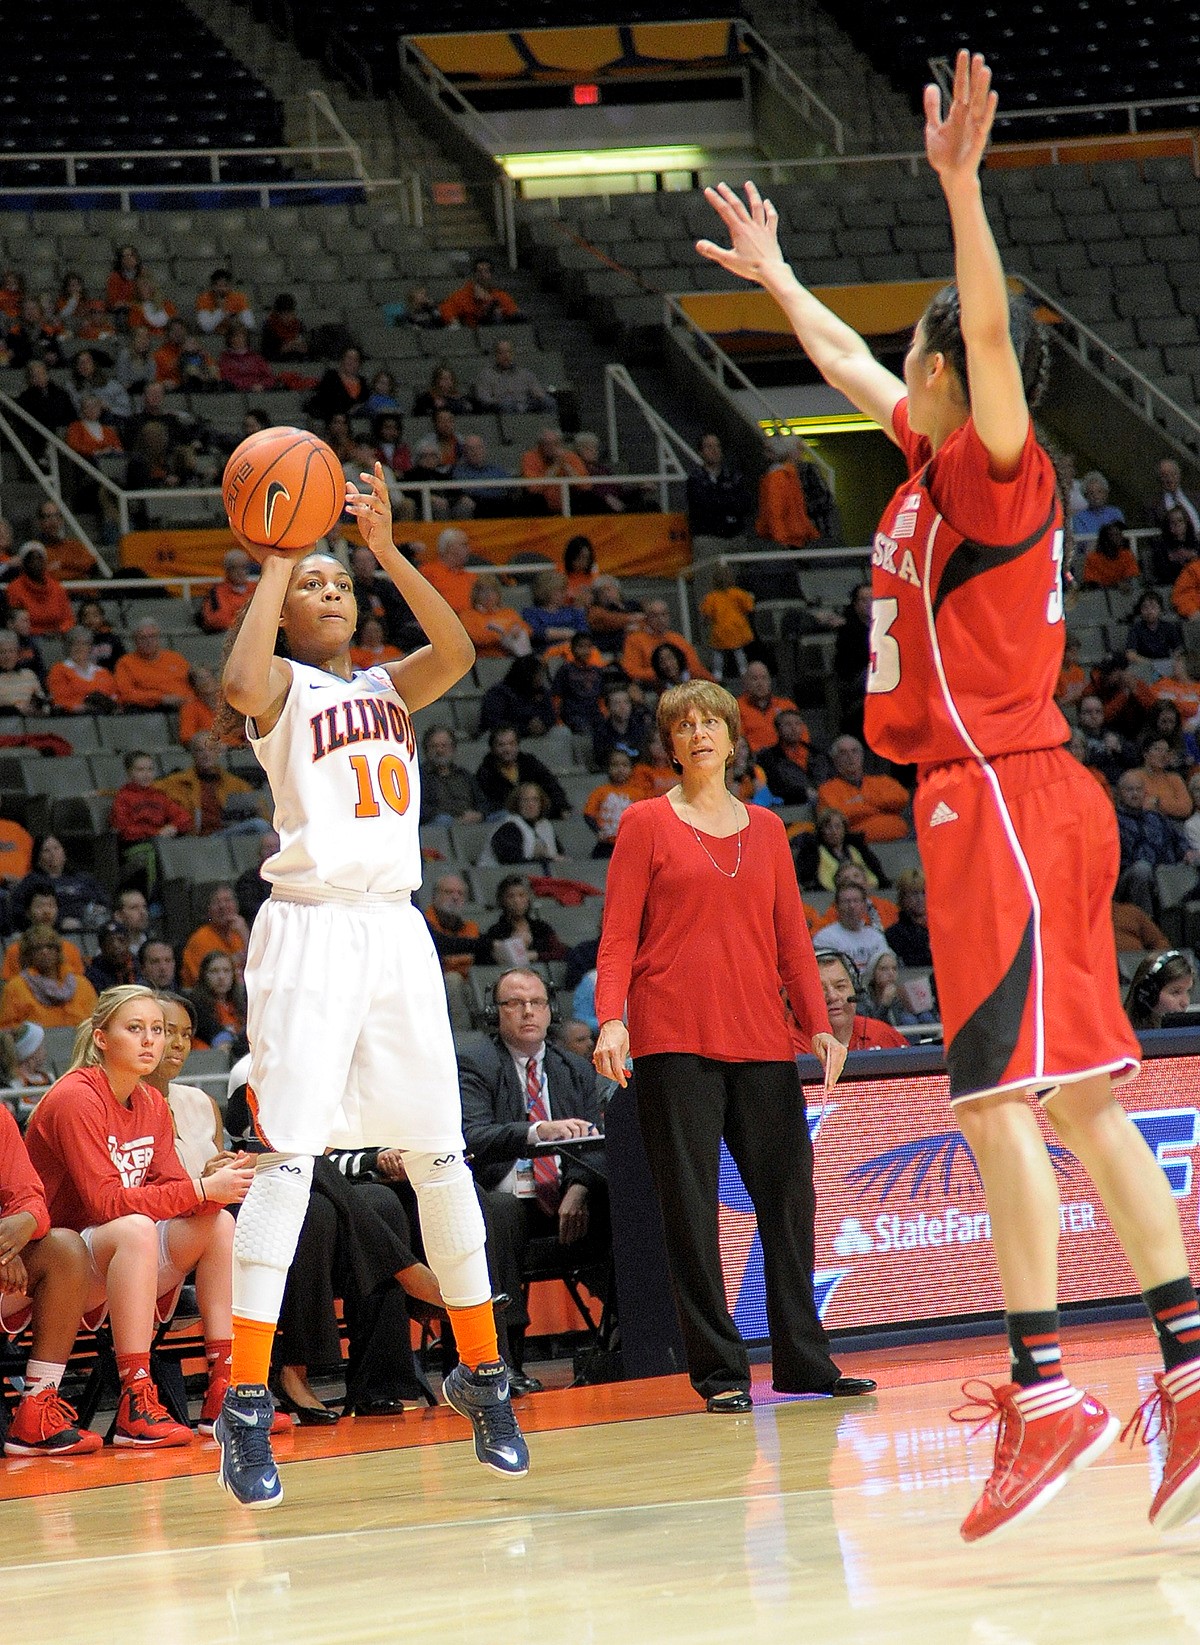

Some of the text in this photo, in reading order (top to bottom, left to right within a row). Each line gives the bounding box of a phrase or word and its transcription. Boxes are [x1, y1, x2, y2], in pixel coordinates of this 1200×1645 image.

[872, 532, 922, 588] SKA
[349, 753, 412, 819] 10
[1058, 1202, 1096, 1232] TER
